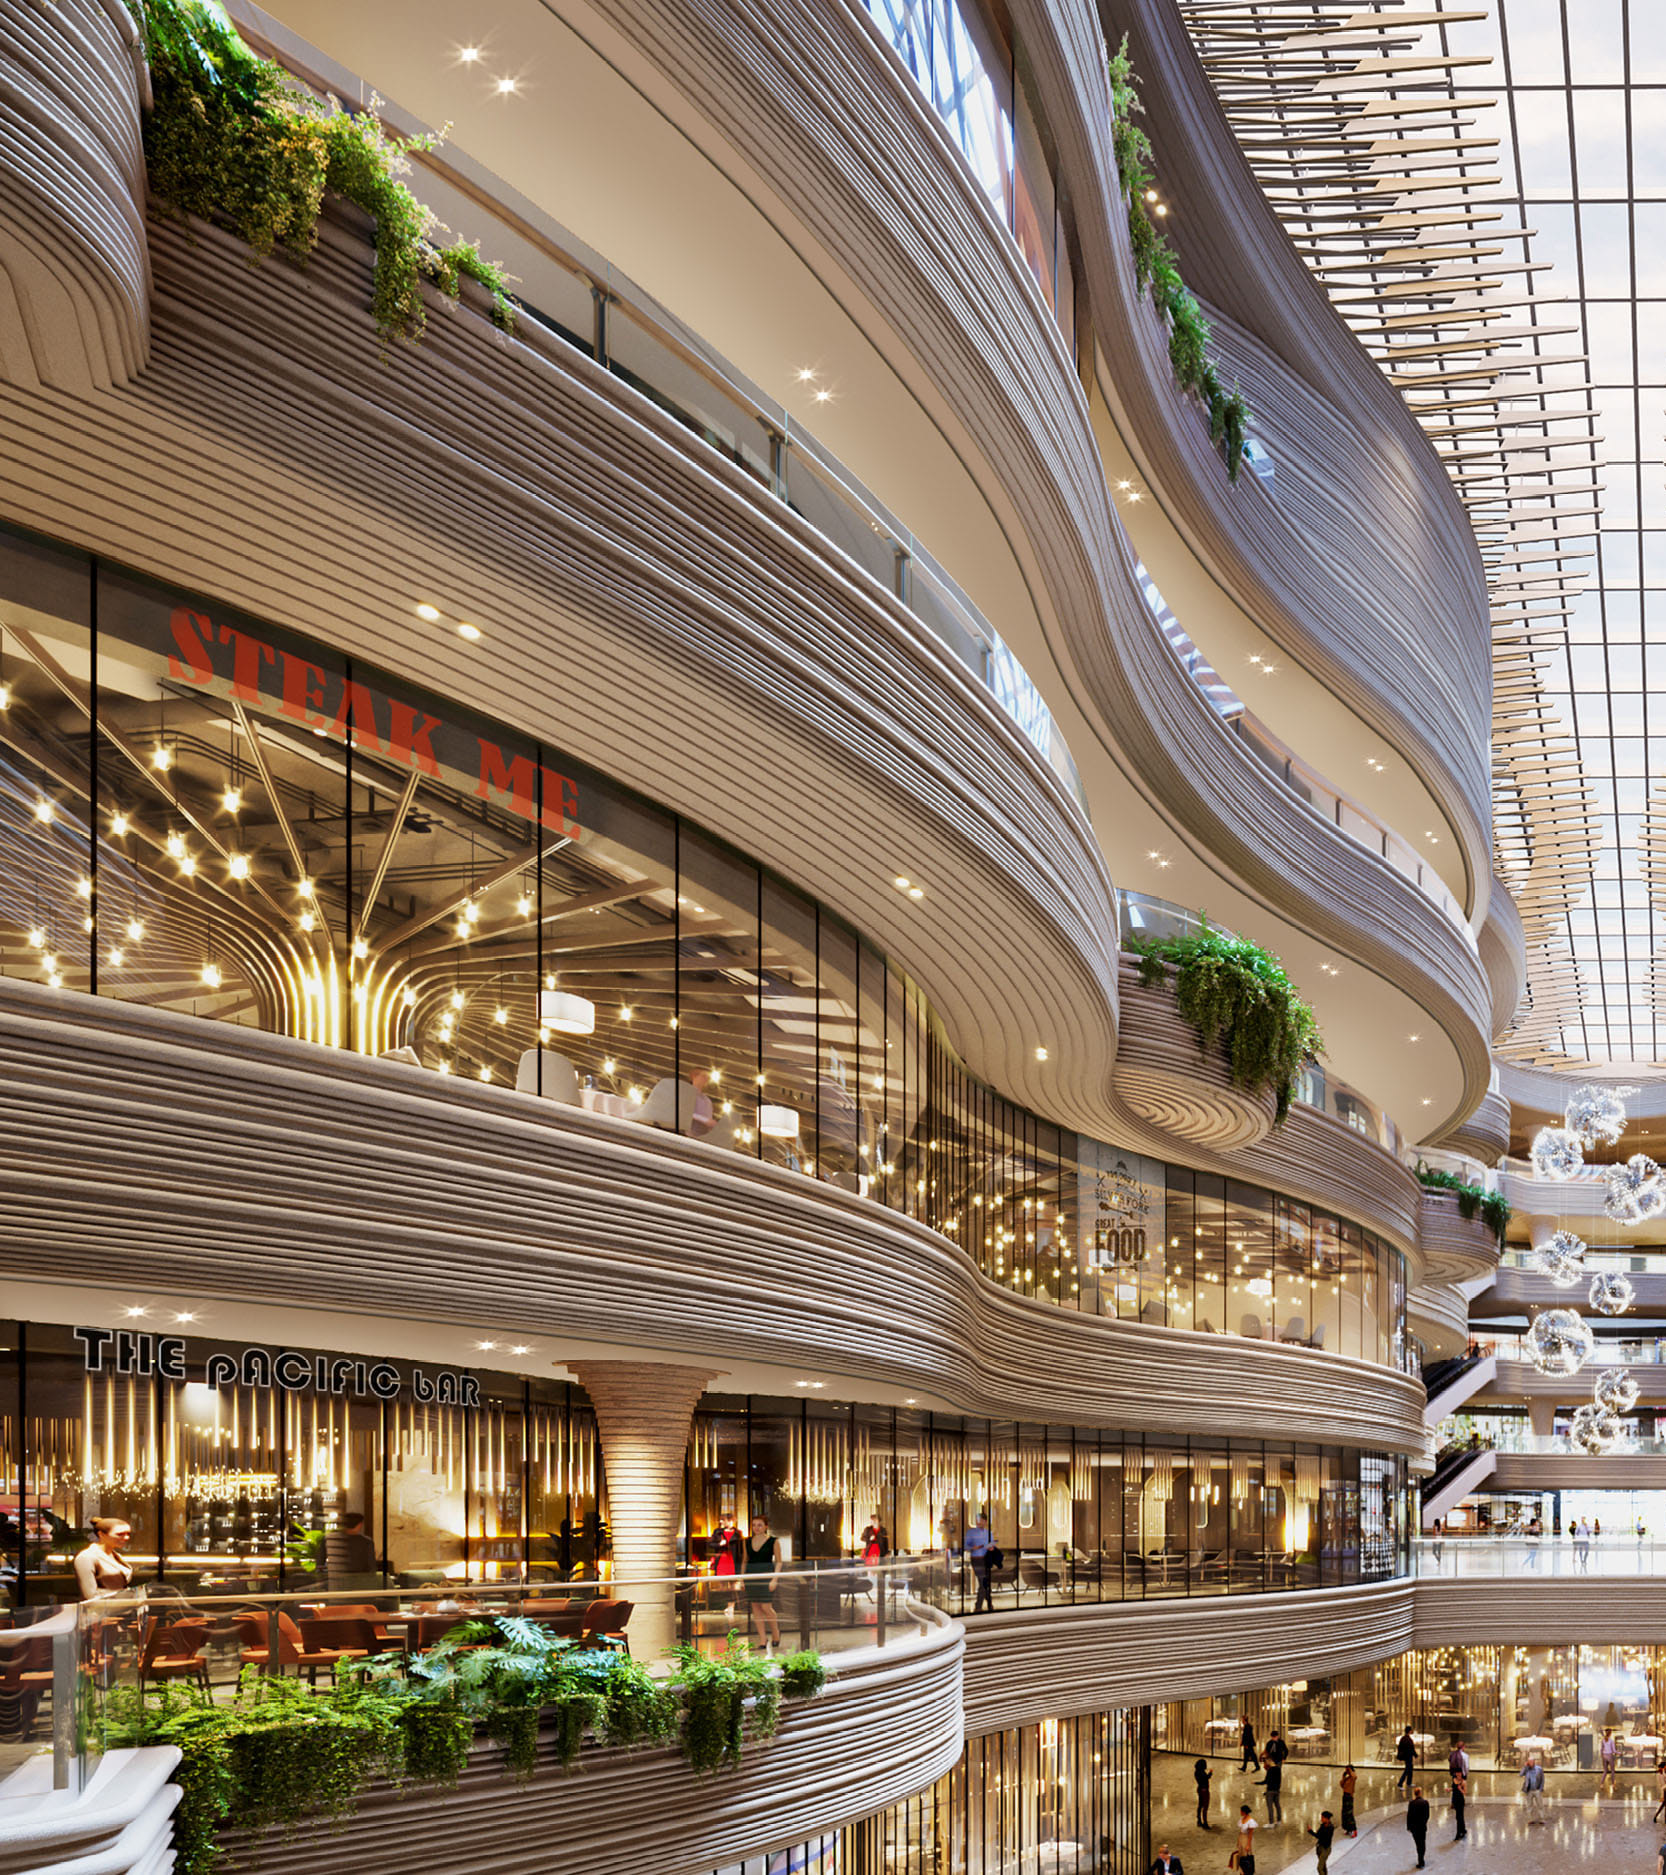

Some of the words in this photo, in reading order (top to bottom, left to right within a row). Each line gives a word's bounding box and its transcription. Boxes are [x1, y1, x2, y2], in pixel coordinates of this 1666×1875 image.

[167, 605, 443, 780] STEAK
[473, 736, 582, 842] ME
[1095, 1228, 1145, 1264] FOOD
[73, 1326, 186, 1380] THE
